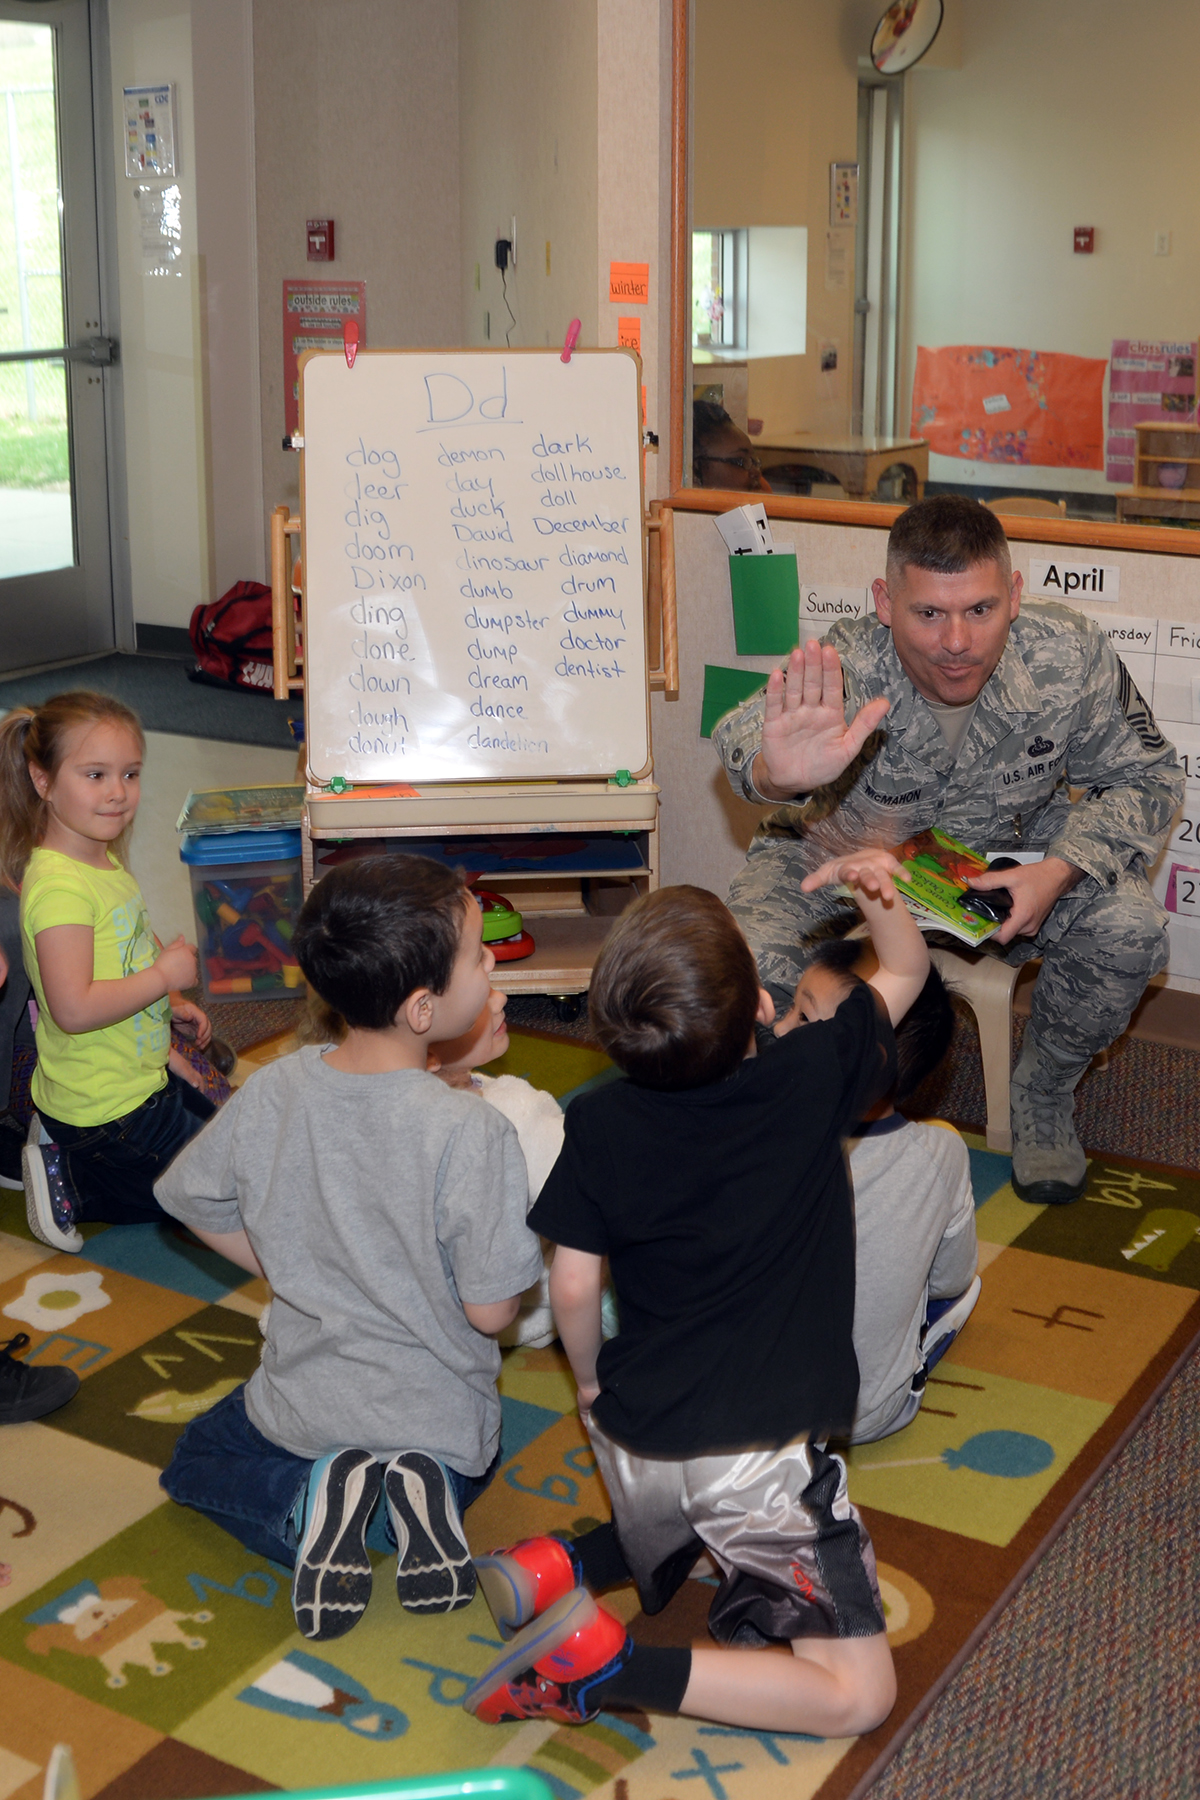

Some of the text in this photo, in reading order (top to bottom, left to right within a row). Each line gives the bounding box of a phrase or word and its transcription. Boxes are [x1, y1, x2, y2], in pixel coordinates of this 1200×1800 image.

[294, 294, 352, 305] outside rules
[611, 280, 646, 296] winter
[620, 334, 638, 350] ice
[424, 366, 507, 422] Dd
[345, 437, 401, 479] dog
[438, 443, 505, 467] demon
[532, 433, 593, 458] dark
[446, 472, 495, 497] day
[450, 498, 506, 518] duck
[541, 489, 577, 507] doll
[345, 500, 390, 540] dig
[452, 522, 514, 543] David
[533, 514, 629, 536] December
[345, 533, 414, 561] doom
[456, 548, 550, 571] dinosaur
[559, 543, 629, 567] diamond
[351, 565, 426, 590] Dixon
[460, 578, 513, 600] dumb
[561, 574, 617, 596] drum
[1043, 565, 1104, 594] April
[350, 595, 408, 640] ding
[563, 601, 624, 629] dummy
[807, 592, 861, 619] Sunday
[465, 606, 550, 635] dumpster
[351, 630, 416, 661] done
[467, 639, 518, 664] dump
[560, 630, 626, 651] doctor
[349, 663, 410, 695] down
[468, 665, 528, 691] dream
[555, 656, 626, 679] dentist
[470, 694, 529, 719] dance
[1003, 756, 1062, 785] U.S. AIR FO
